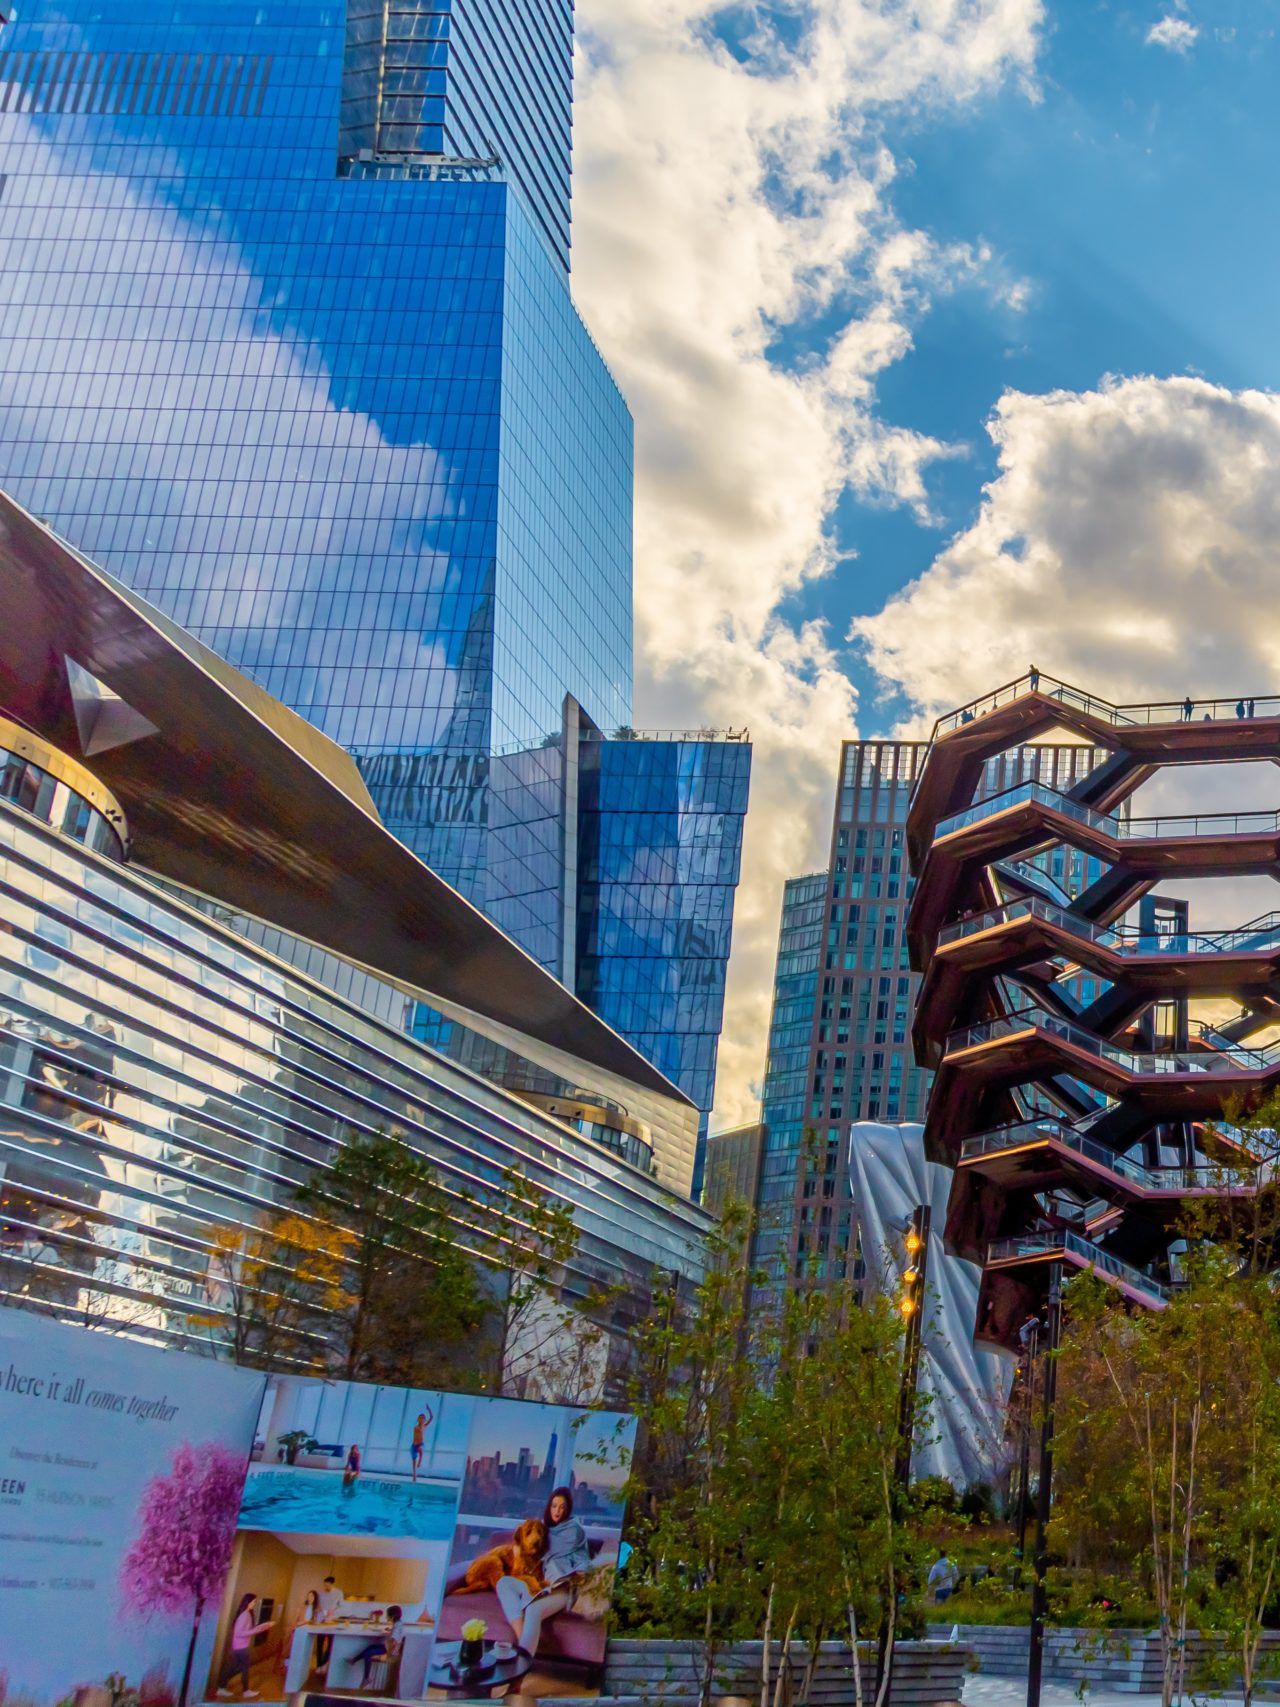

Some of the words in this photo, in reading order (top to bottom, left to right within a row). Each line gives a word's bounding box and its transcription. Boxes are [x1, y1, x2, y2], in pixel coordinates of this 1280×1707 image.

[48, 1372, 61, 1401] it
[63, 1378, 86, 1405] all
[85, 1389, 127, 1413] comes
[126, 1395, 179, 1425] together
[0, 1478, 26, 1494] EEN
[380, 1482, 401, 1493] DEEP
